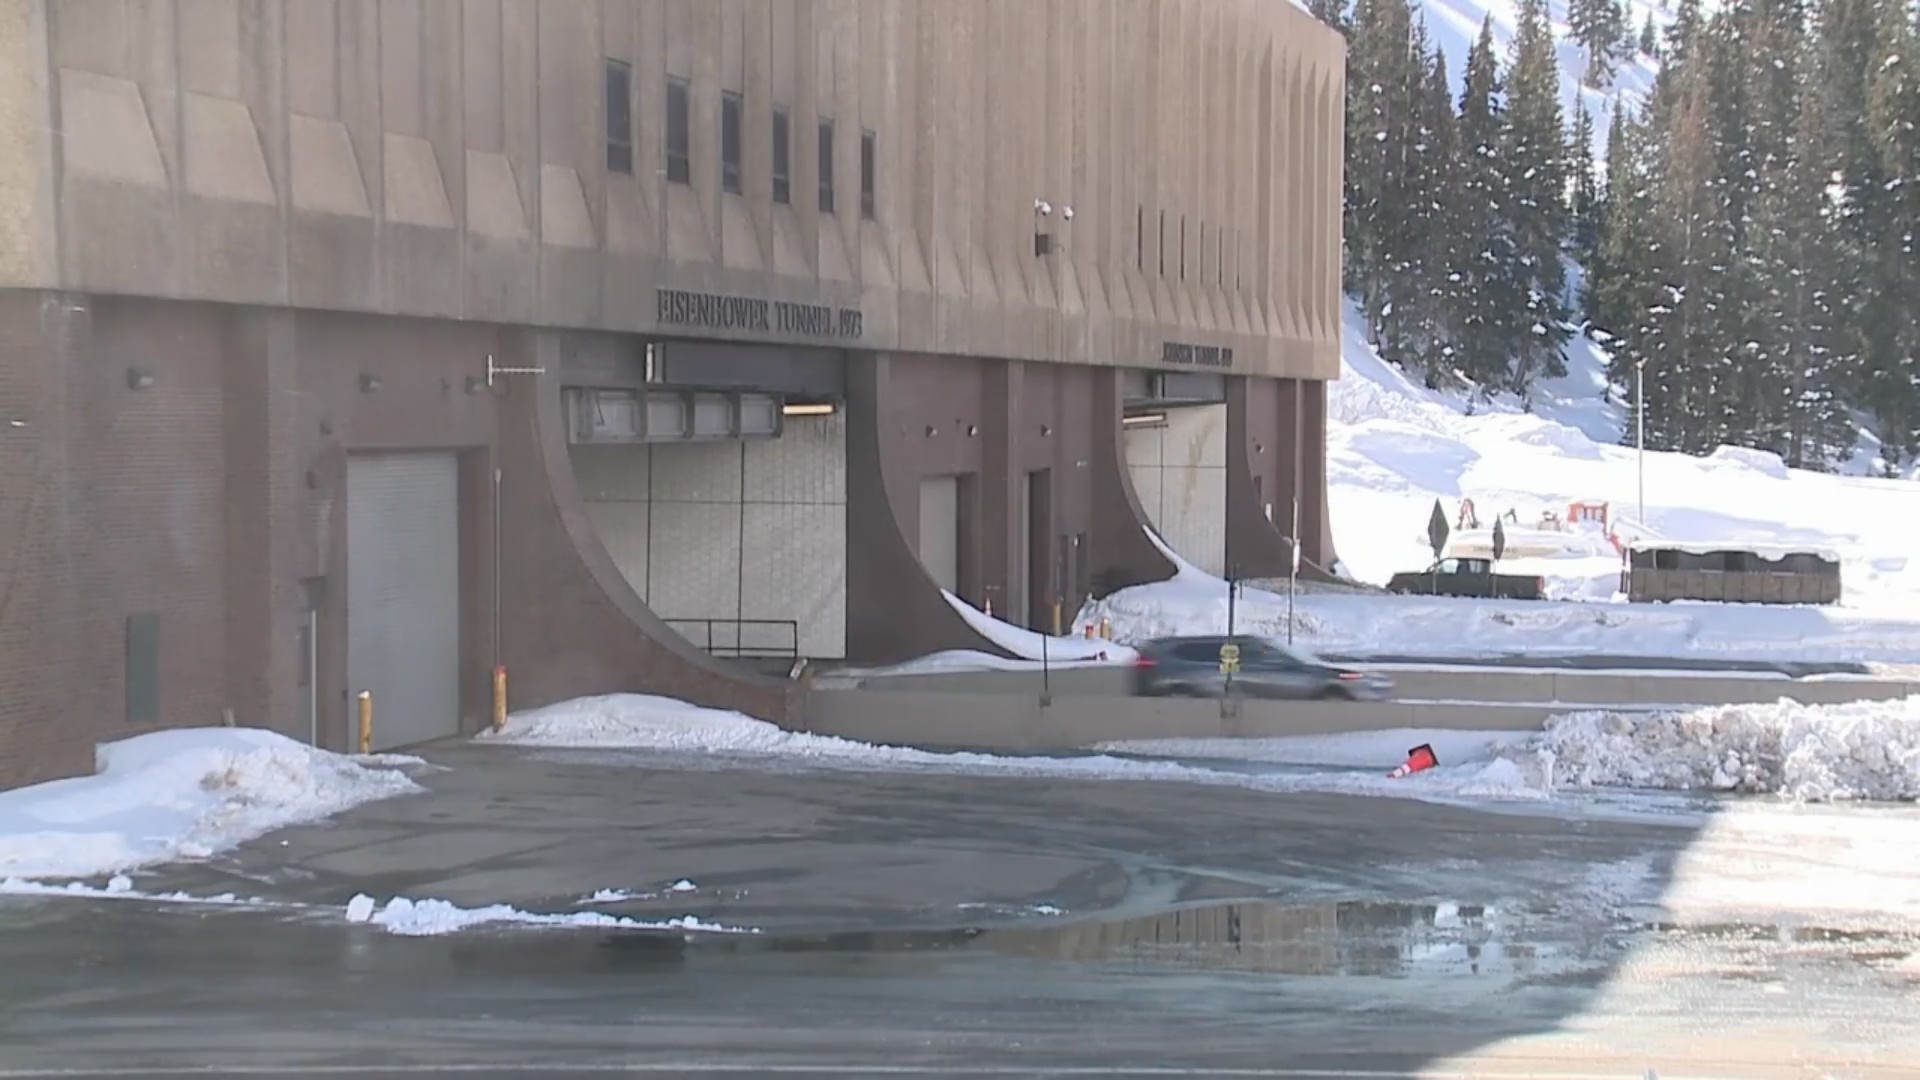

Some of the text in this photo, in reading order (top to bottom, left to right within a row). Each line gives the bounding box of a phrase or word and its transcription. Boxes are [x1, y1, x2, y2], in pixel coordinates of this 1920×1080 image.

[656, 288, 863, 339] EISENHOWER TUNNEL 1973
